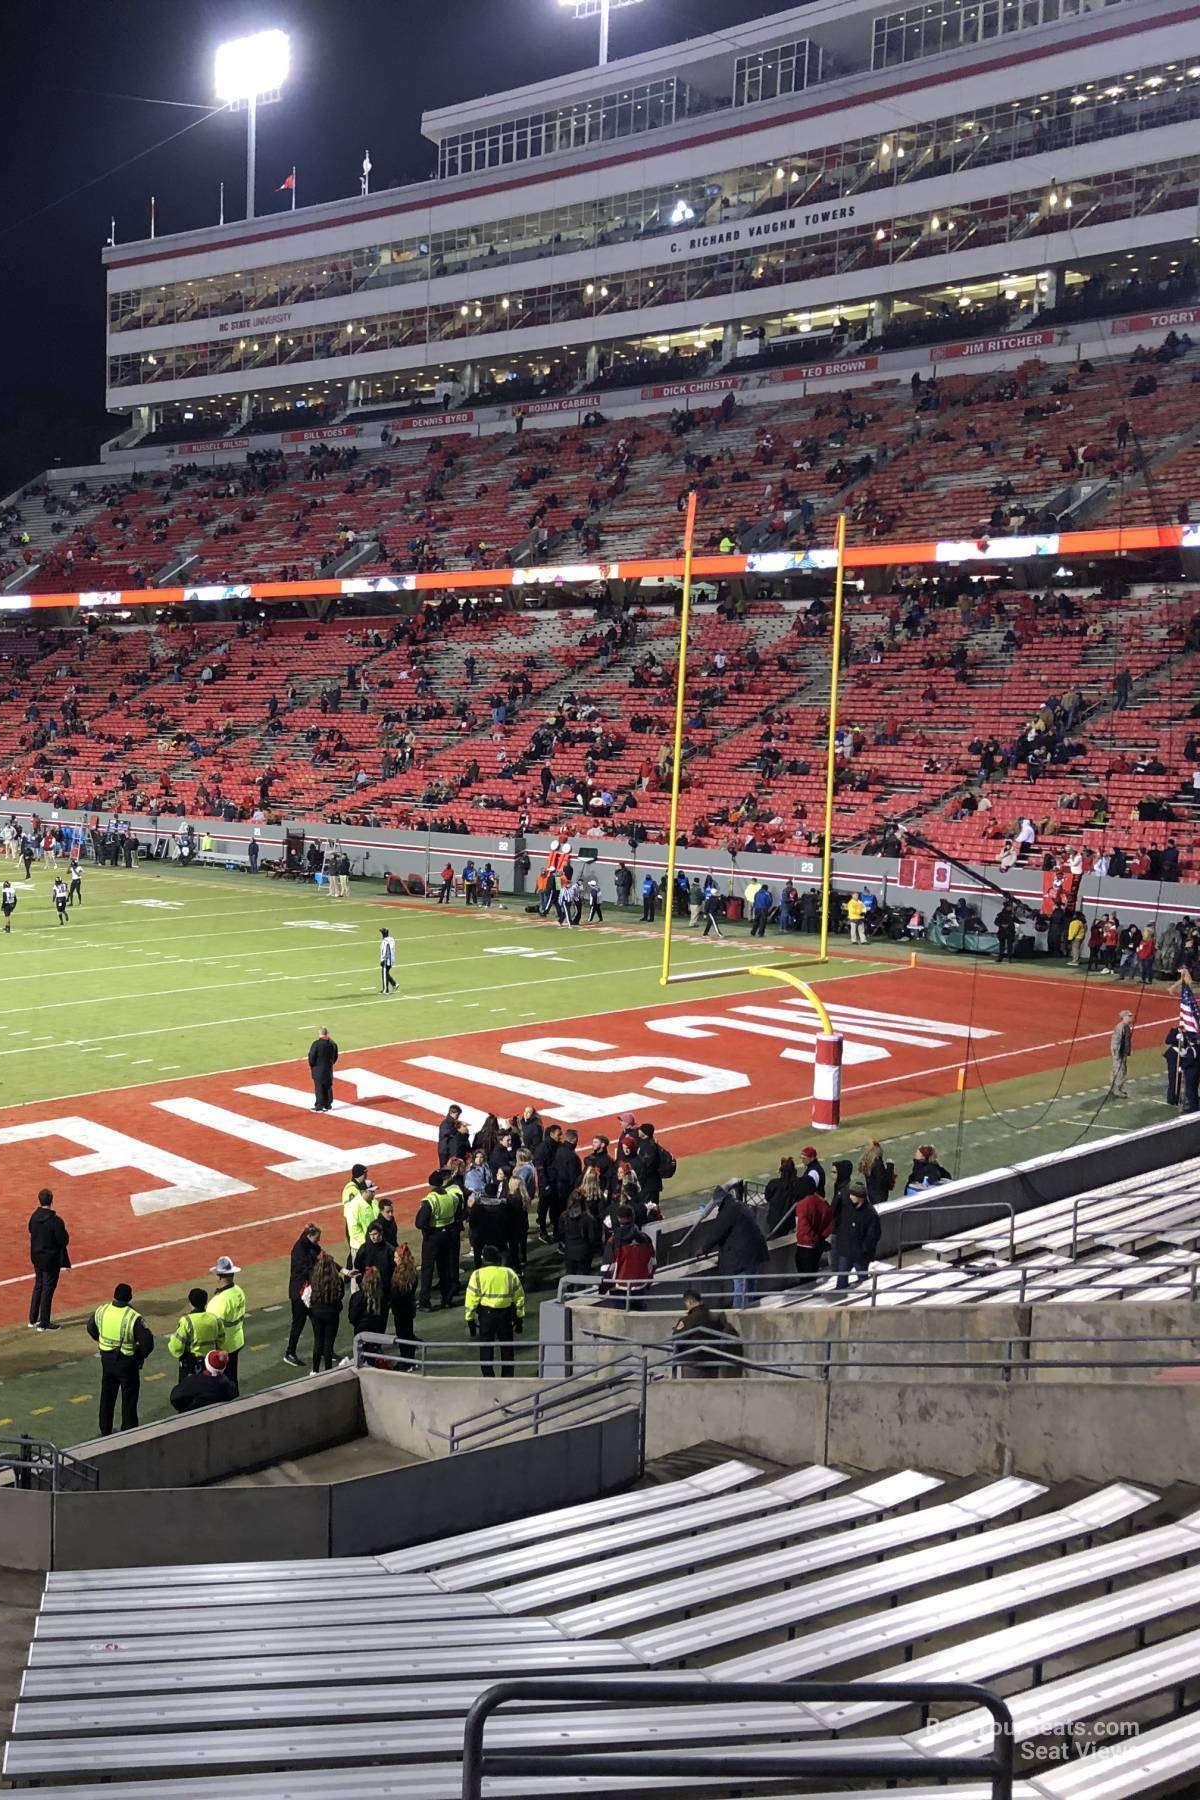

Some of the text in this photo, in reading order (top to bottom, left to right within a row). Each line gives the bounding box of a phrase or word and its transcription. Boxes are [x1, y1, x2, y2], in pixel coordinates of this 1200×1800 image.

[689, 230, 740, 250] RICHARD
[748, 218, 796, 237] VAUGHN
[804, 206, 856, 226] TOWERS
[231, 318, 251, 331] STATE
[253, 312, 292, 328] UNIVERSITY
[1150, 310, 1199, 328] TORRY
[962, 343, 985, 356] JIM
[987, 334, 1043, 352] RITCHER
[800, 367, 823, 379] TED
[825, 360, 867, 375] BROWN
[662, 384, 687, 397] DICK
[689, 379, 733, 393] CHRISTY
[528, 397, 600, 414] ROMAN GABRIEL
[412, 413, 469, 428] DENNIS BYRD
[303, 428, 349, 440] BILL YOEST
[801, 862, 814, 873] 23
